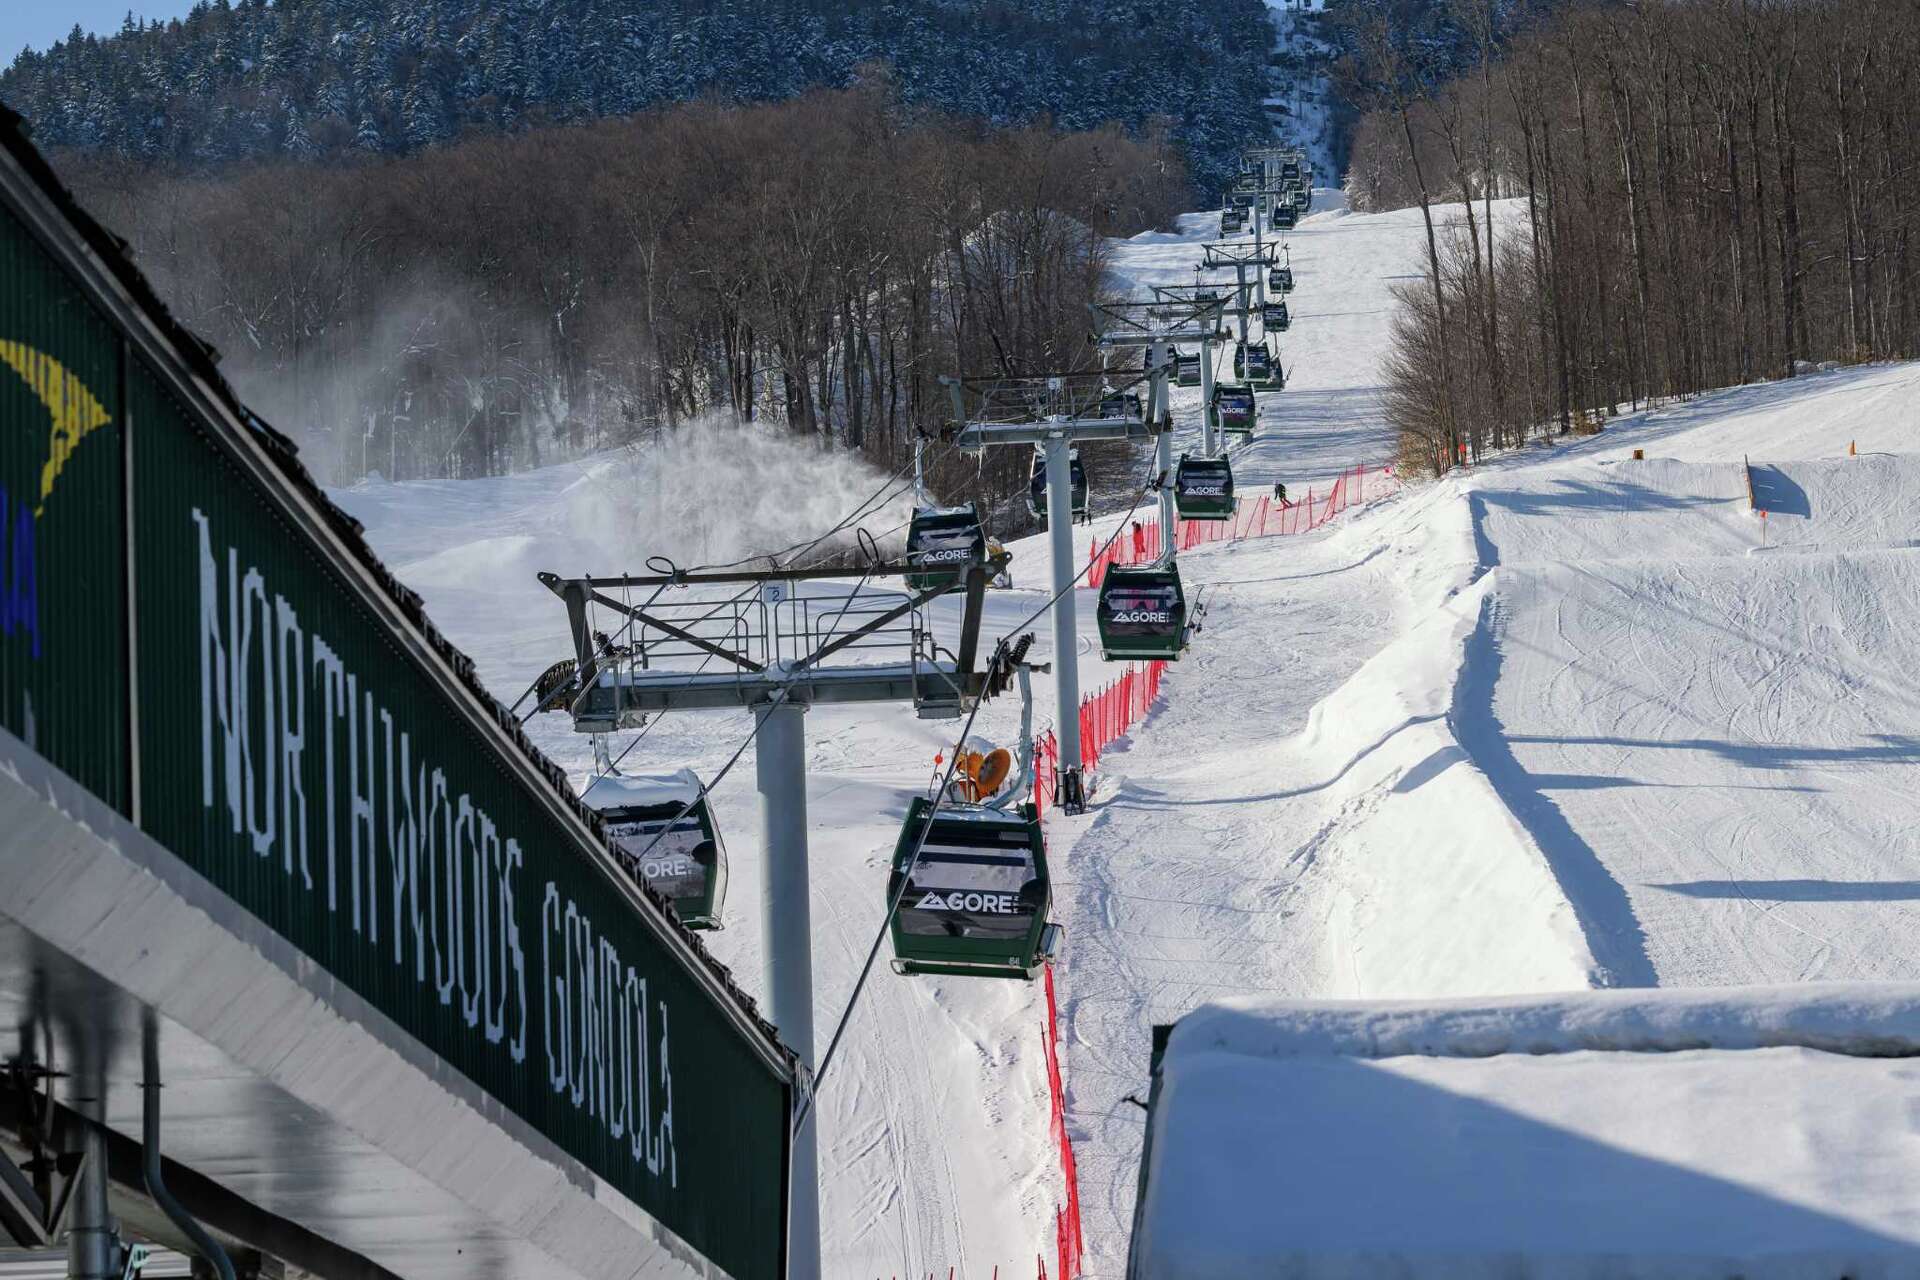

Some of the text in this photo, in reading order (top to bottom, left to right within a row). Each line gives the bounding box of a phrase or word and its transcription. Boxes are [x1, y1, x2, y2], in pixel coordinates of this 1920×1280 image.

[1196, 486, 1222, 495] GORE
[936, 549, 969, 561] GORE
[772, 589, 780, 602] 2
[1130, 611, 1166, 623] GORE
[193, 507, 526, 1064] NORTHWOODS
[543, 881, 676, 1188] GONDOLA
[644, 859, 687, 878] ORE
[946, 892, 1012, 914] GORE
